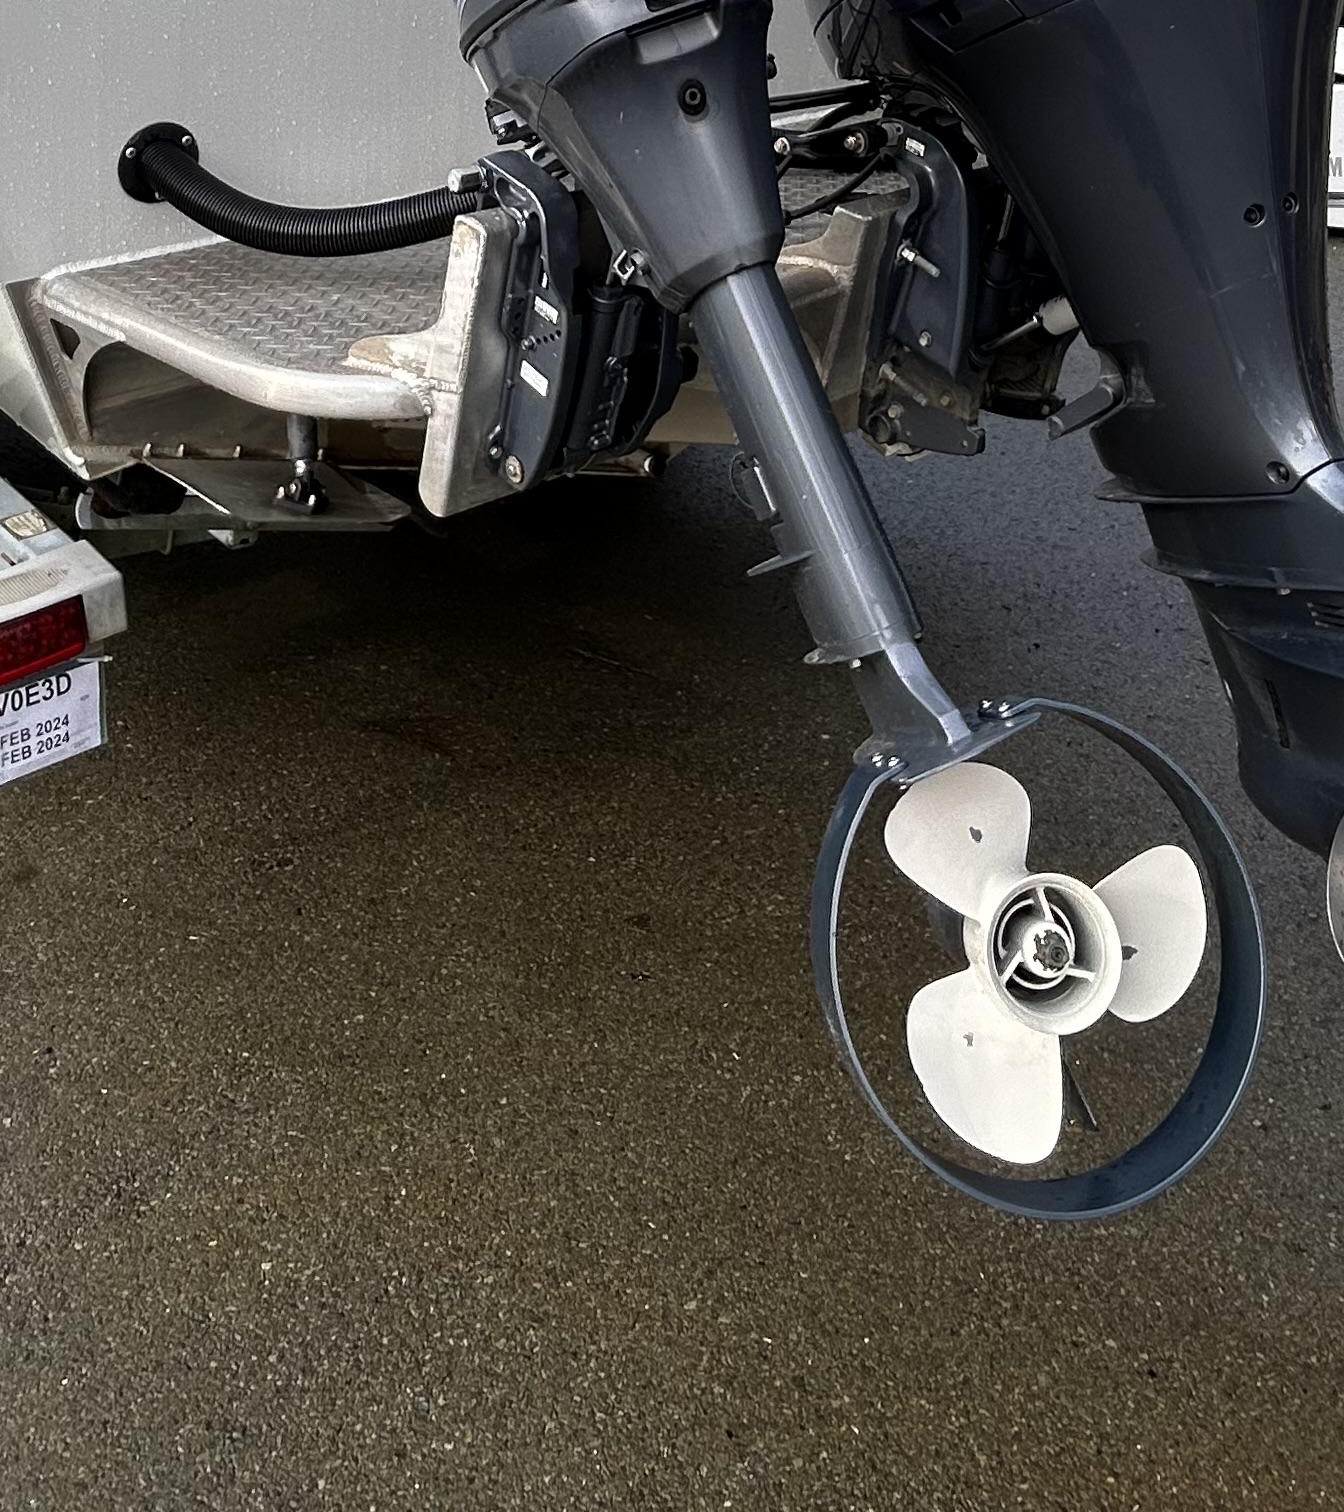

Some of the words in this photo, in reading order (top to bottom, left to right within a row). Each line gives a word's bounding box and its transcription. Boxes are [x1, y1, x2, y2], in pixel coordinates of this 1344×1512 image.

[0, 727, 32, 750] FEB
[36, 713, 70, 737] 2024
[1, 744, 33, 768] FEB
[36, 730, 70, 755] 2024
